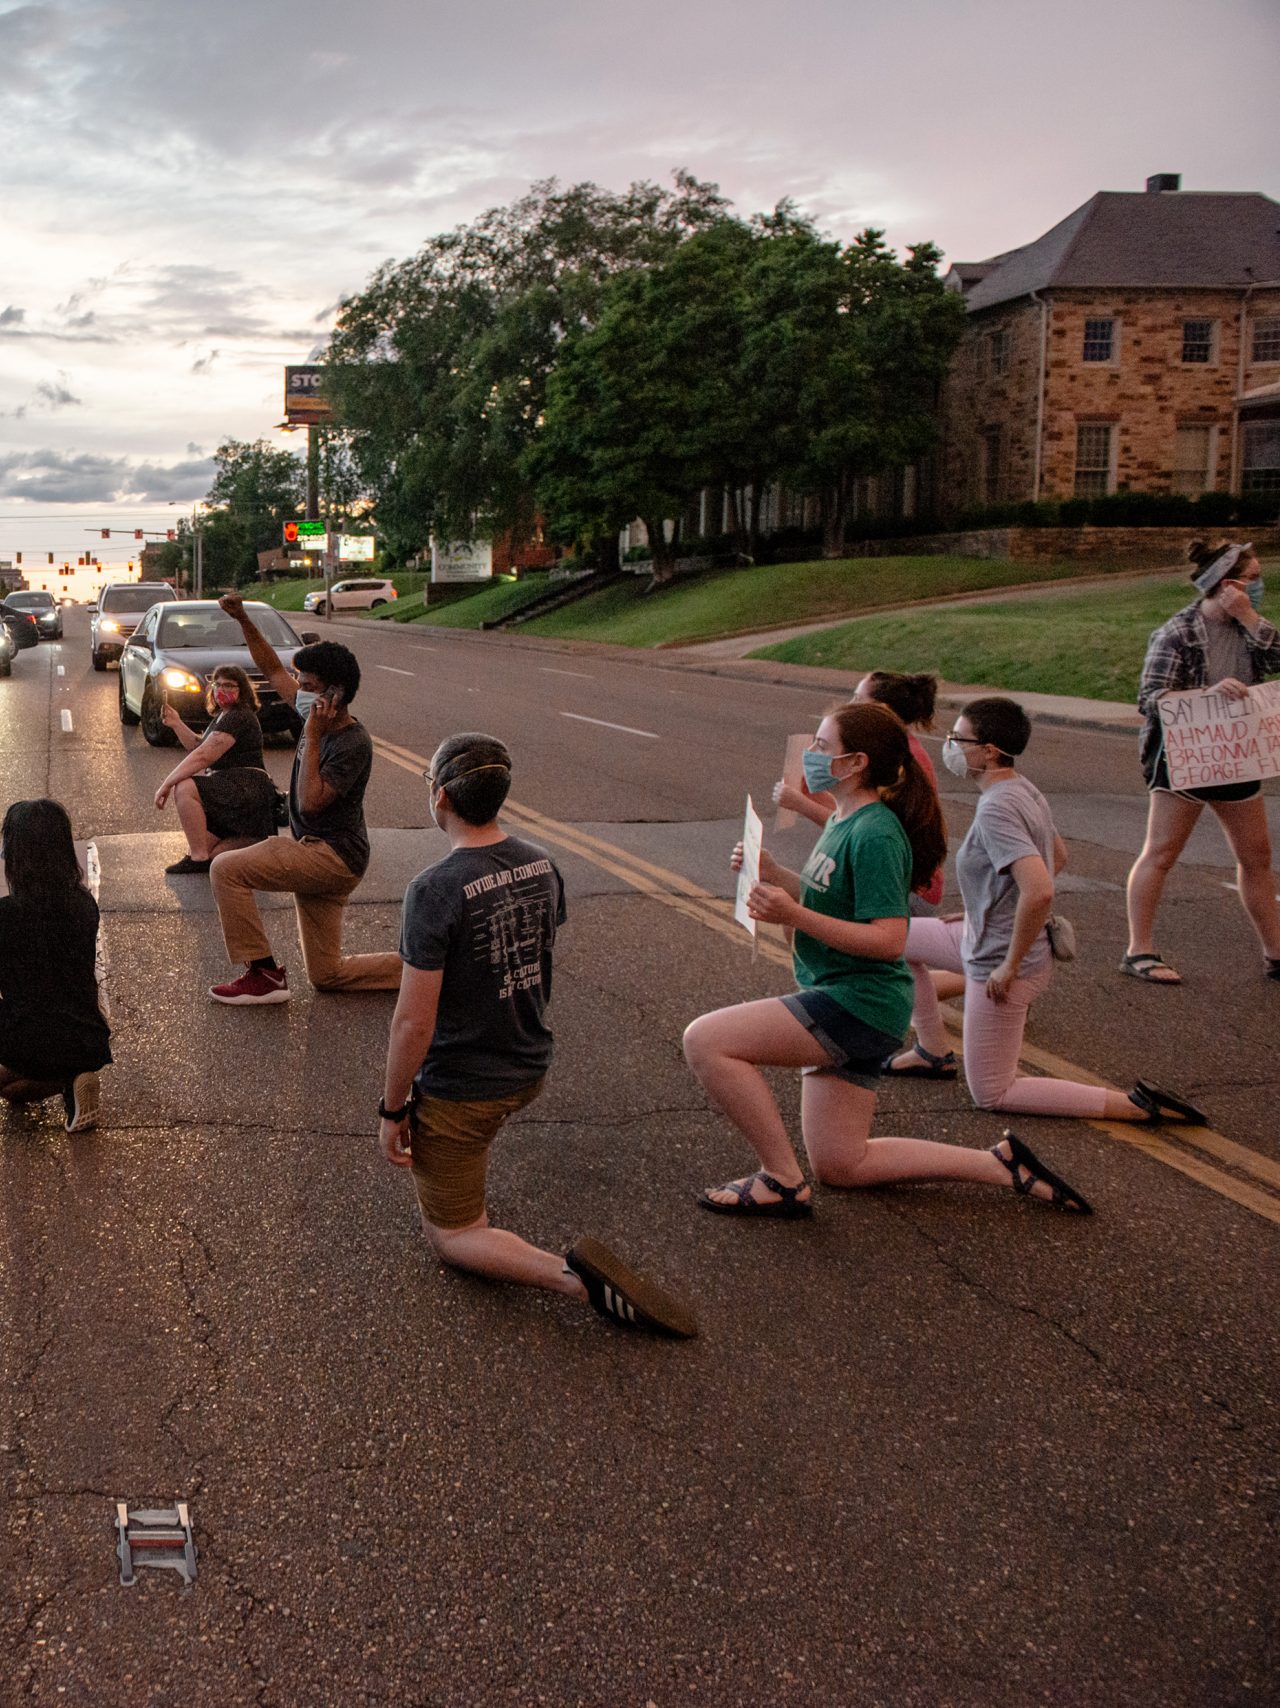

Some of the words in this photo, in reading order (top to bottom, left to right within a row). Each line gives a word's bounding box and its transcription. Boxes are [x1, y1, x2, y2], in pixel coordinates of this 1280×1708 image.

[1161, 698, 1193, 726] SAY
[1166, 720, 1249, 748] AHMAUD
[1167, 737, 1262, 768] BREONNA
[1170, 762, 1246, 788] GEORGE
[463, 873, 497, 899] DIVIDE
[495, 869, 513, 886] AND
